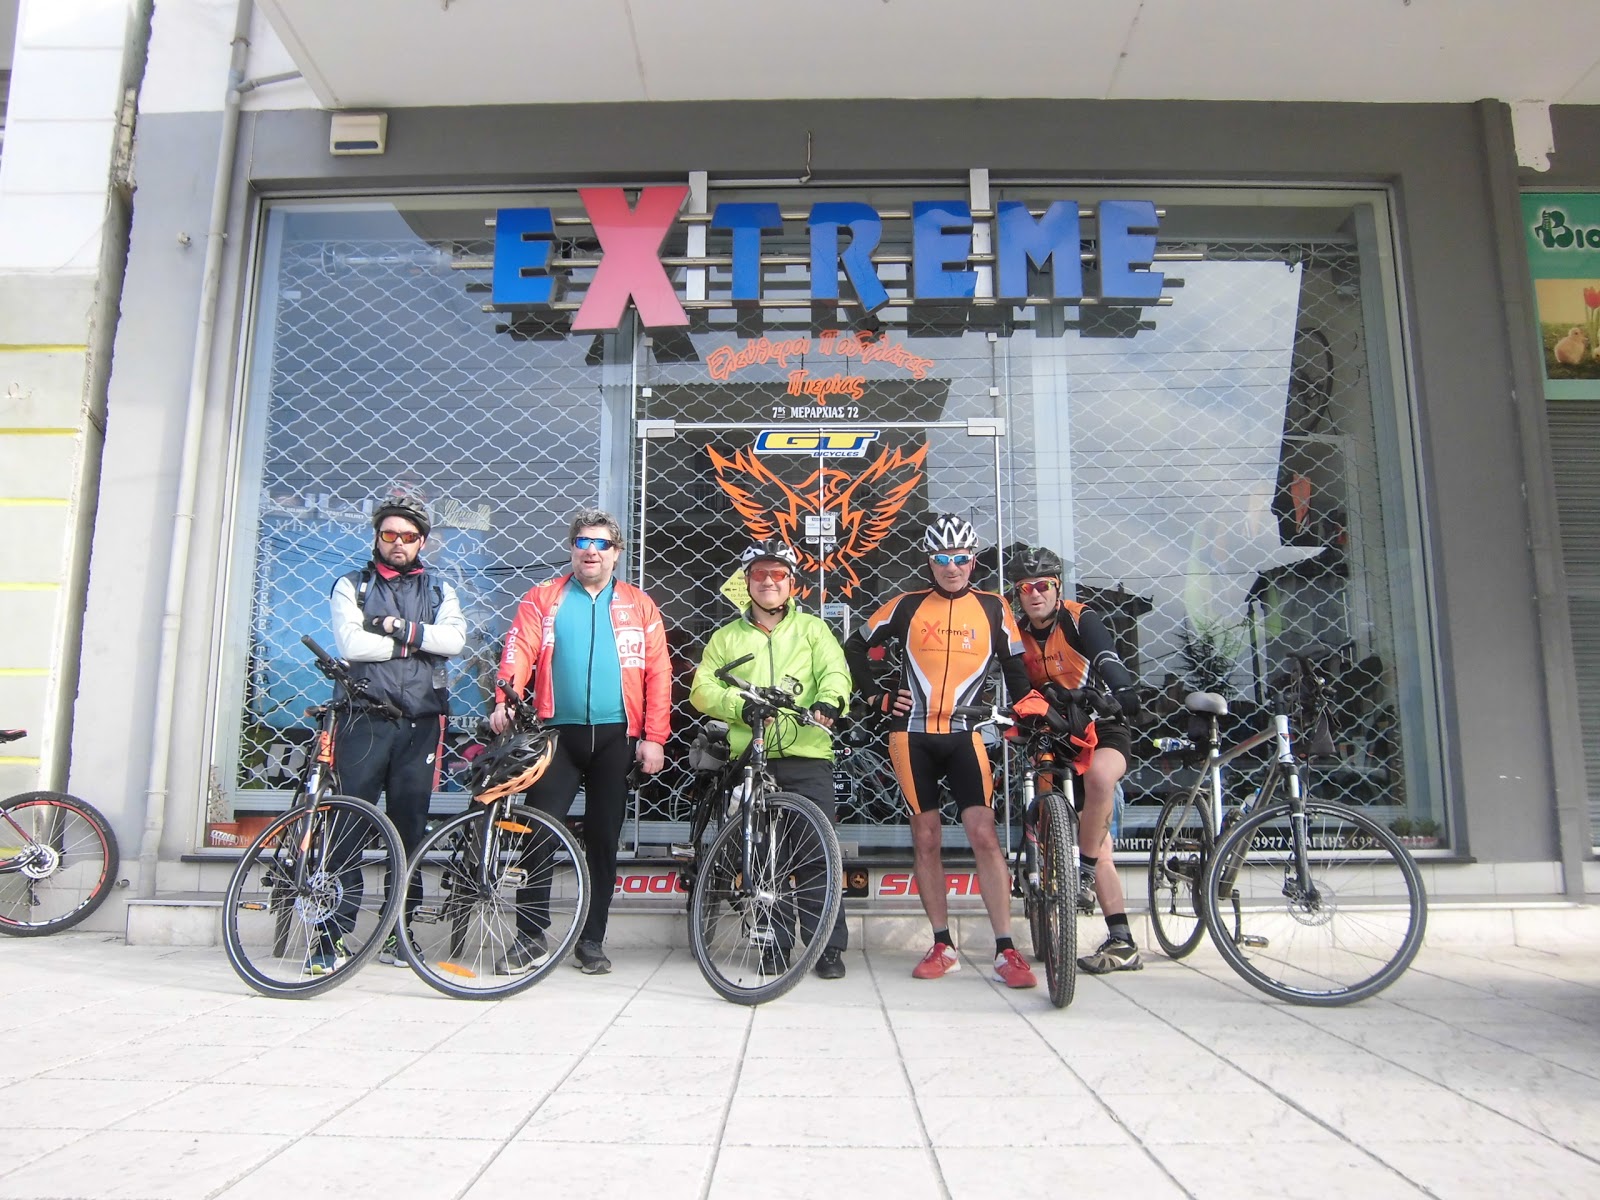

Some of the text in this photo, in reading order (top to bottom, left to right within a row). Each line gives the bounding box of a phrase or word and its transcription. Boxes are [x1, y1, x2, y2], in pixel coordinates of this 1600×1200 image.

[790, 406, 845, 418] ΜΕΡΑΡΧΙΑΣ
[847, 406, 859, 418] 72
[756, 430, 879, 450] GT
